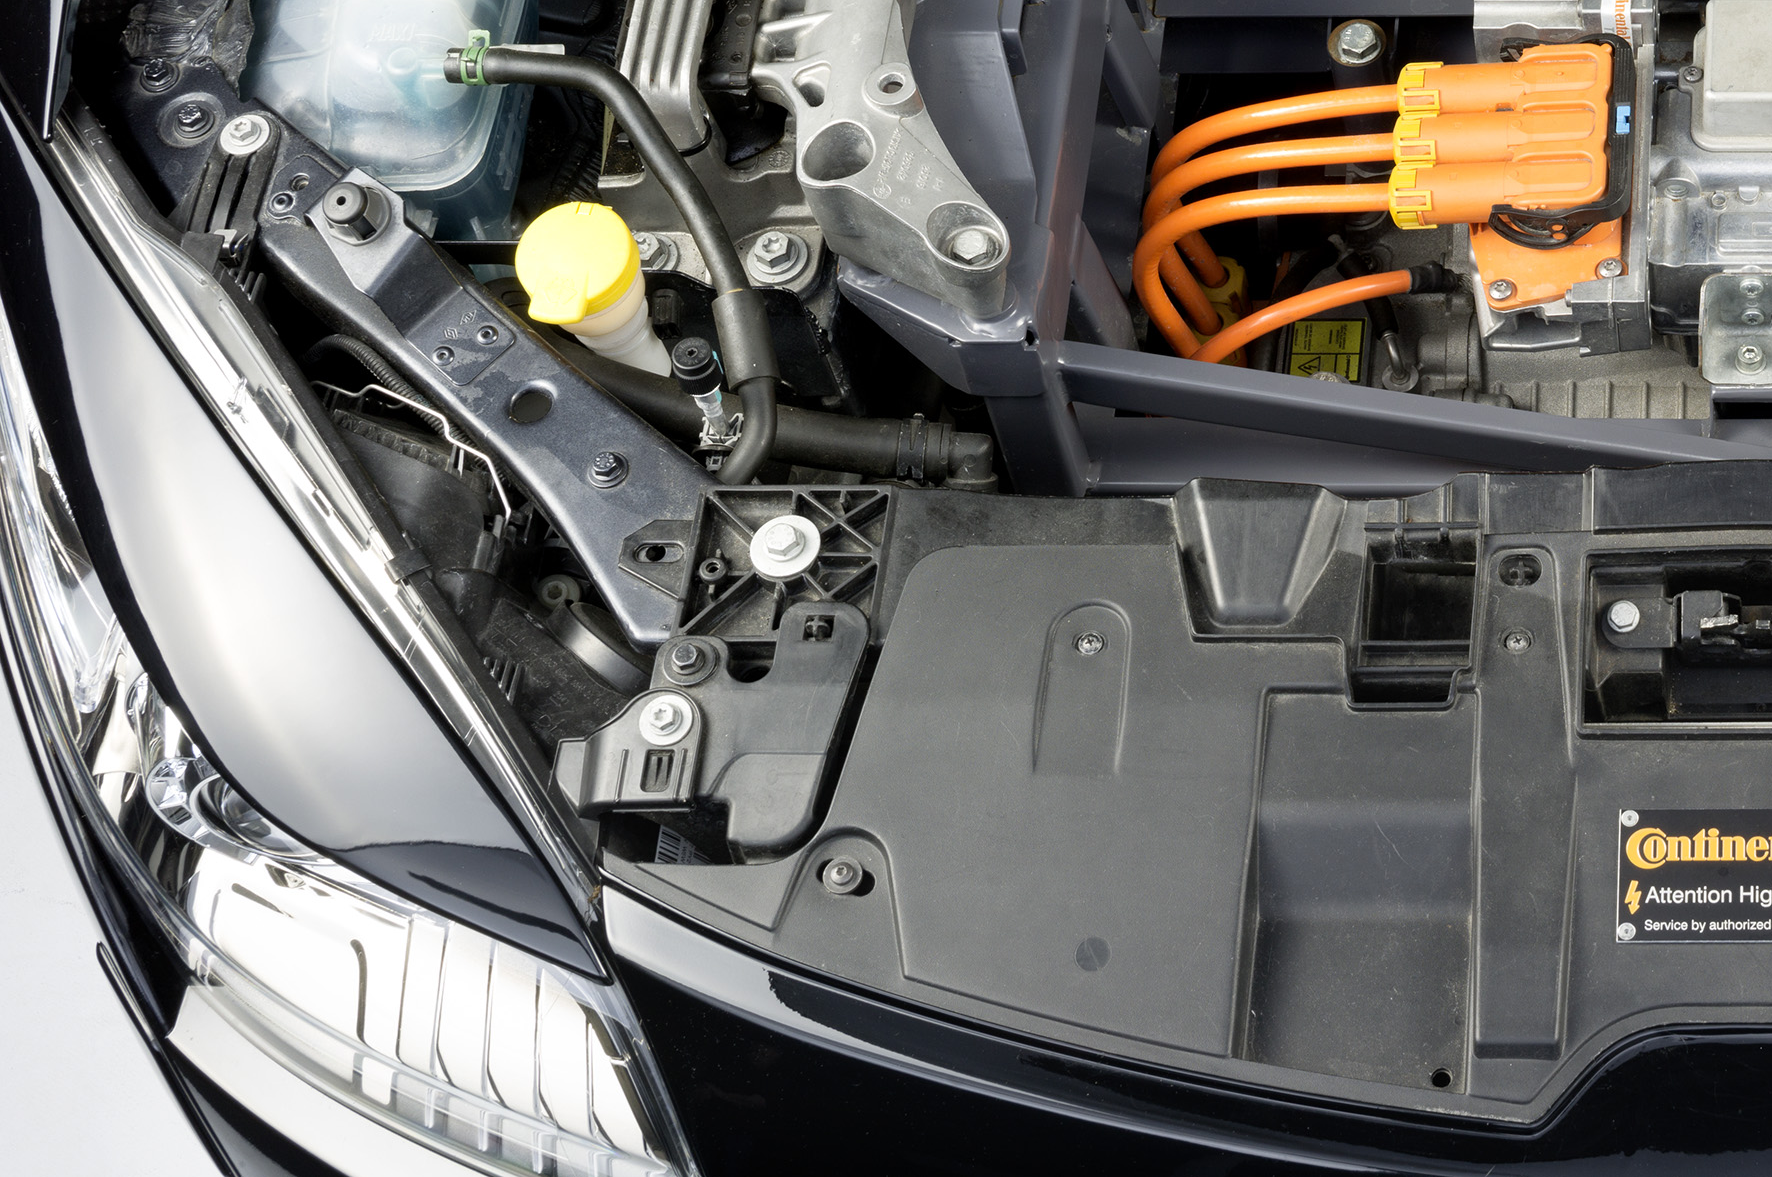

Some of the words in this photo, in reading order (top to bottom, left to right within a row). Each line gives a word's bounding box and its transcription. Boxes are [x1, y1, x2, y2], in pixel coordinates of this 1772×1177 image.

[1645, 885, 1732, 904] Attention
[1644, 919, 1688, 931] Service
[1691, 919, 1706, 933] by
[1710, 919, 1772, 931] authorized
